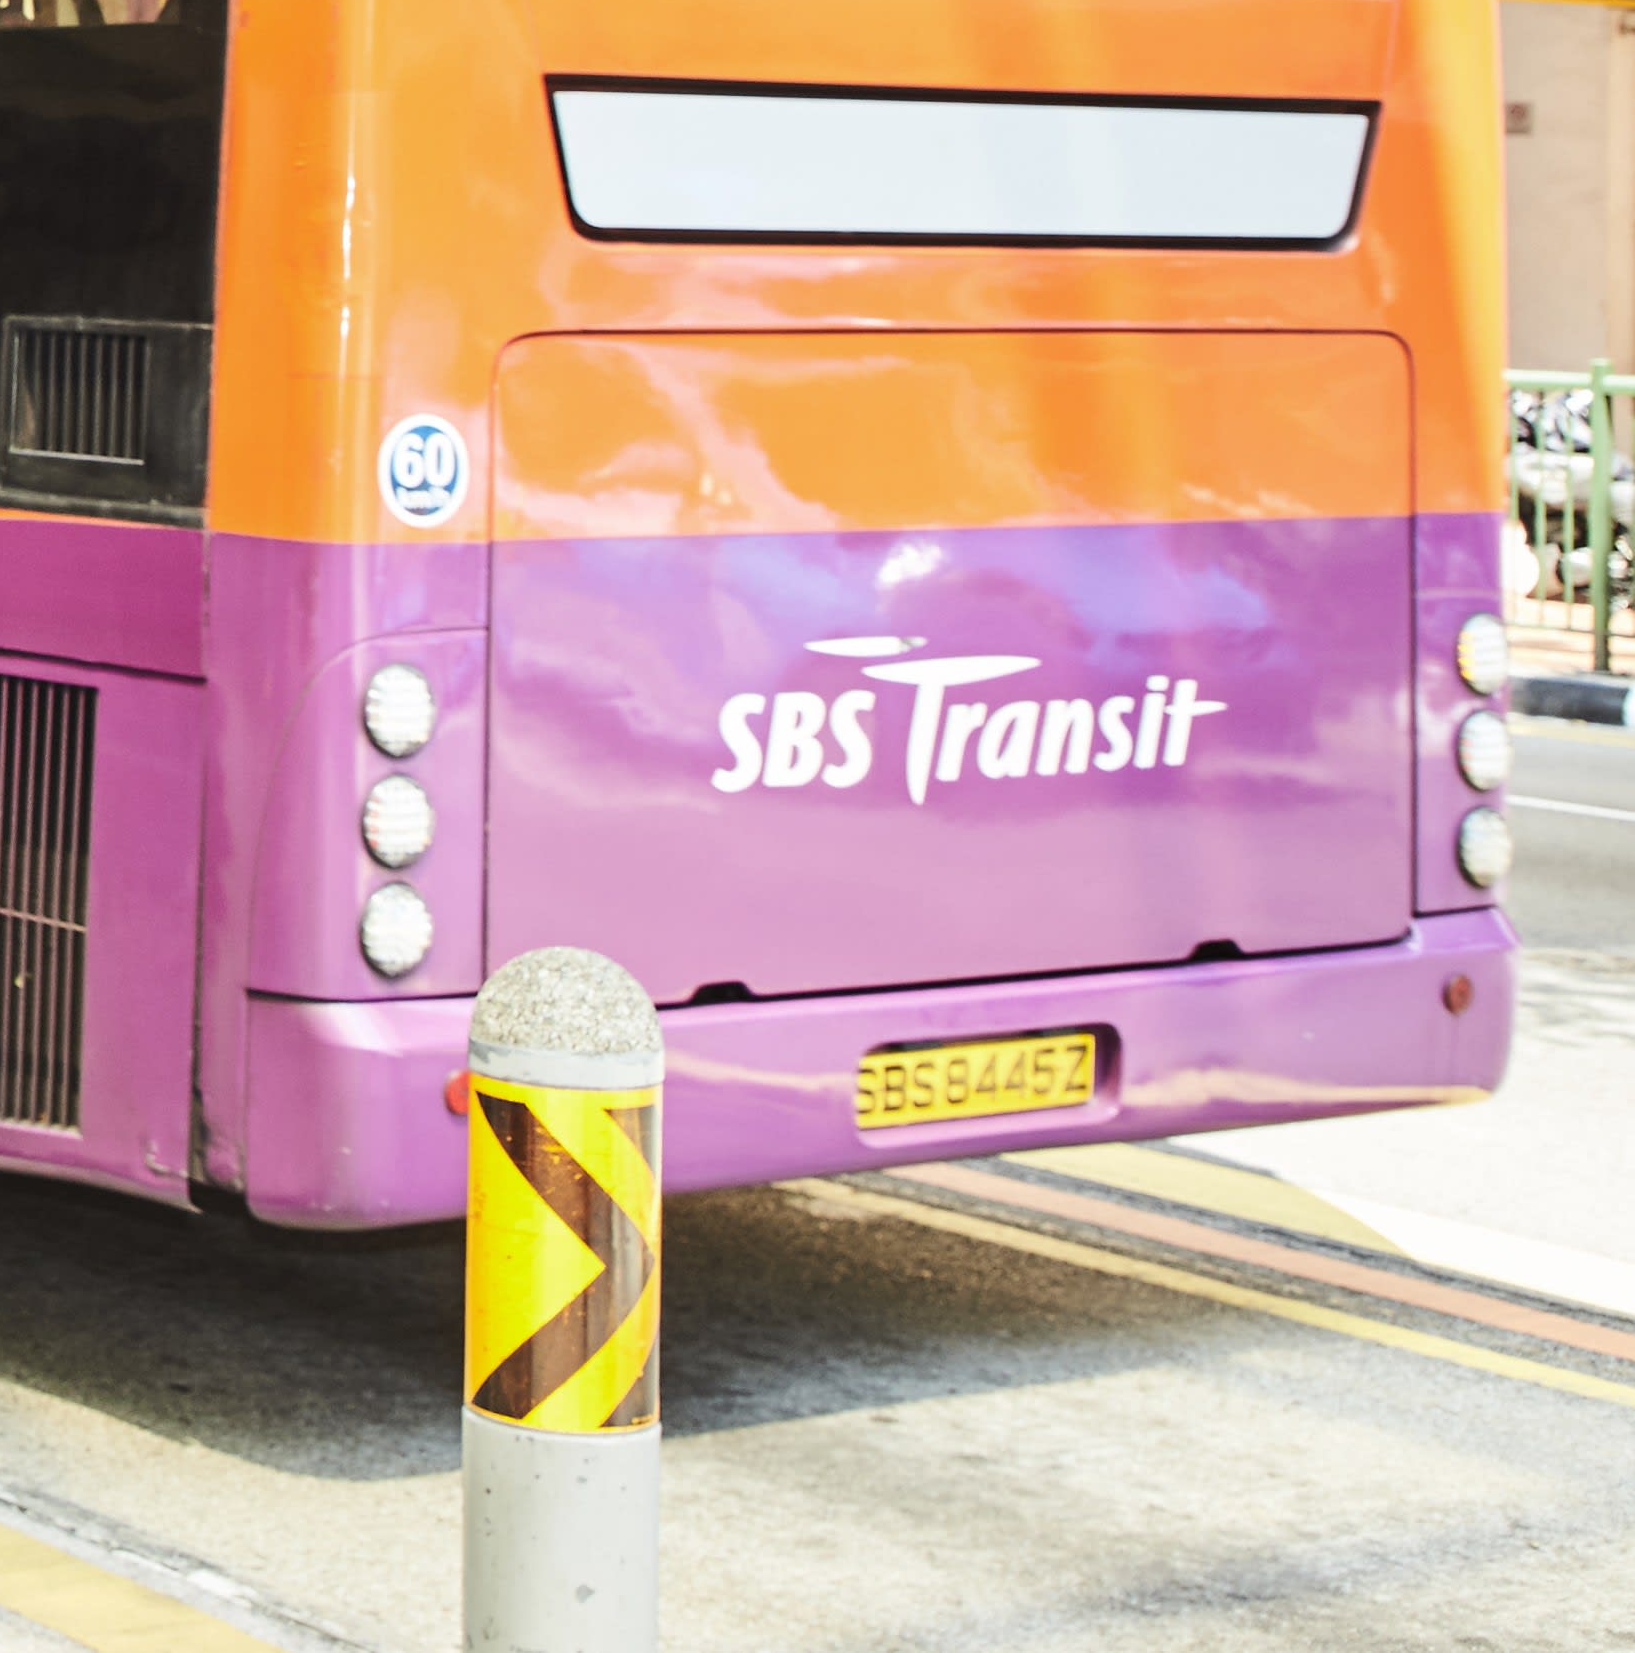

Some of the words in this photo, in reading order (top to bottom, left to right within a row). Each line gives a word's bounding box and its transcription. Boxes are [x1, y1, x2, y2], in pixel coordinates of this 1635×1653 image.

[394, 432, 456, 489] 60
[709, 688, 878, 794] SBS
[860, 654, 1229, 806] Transit
